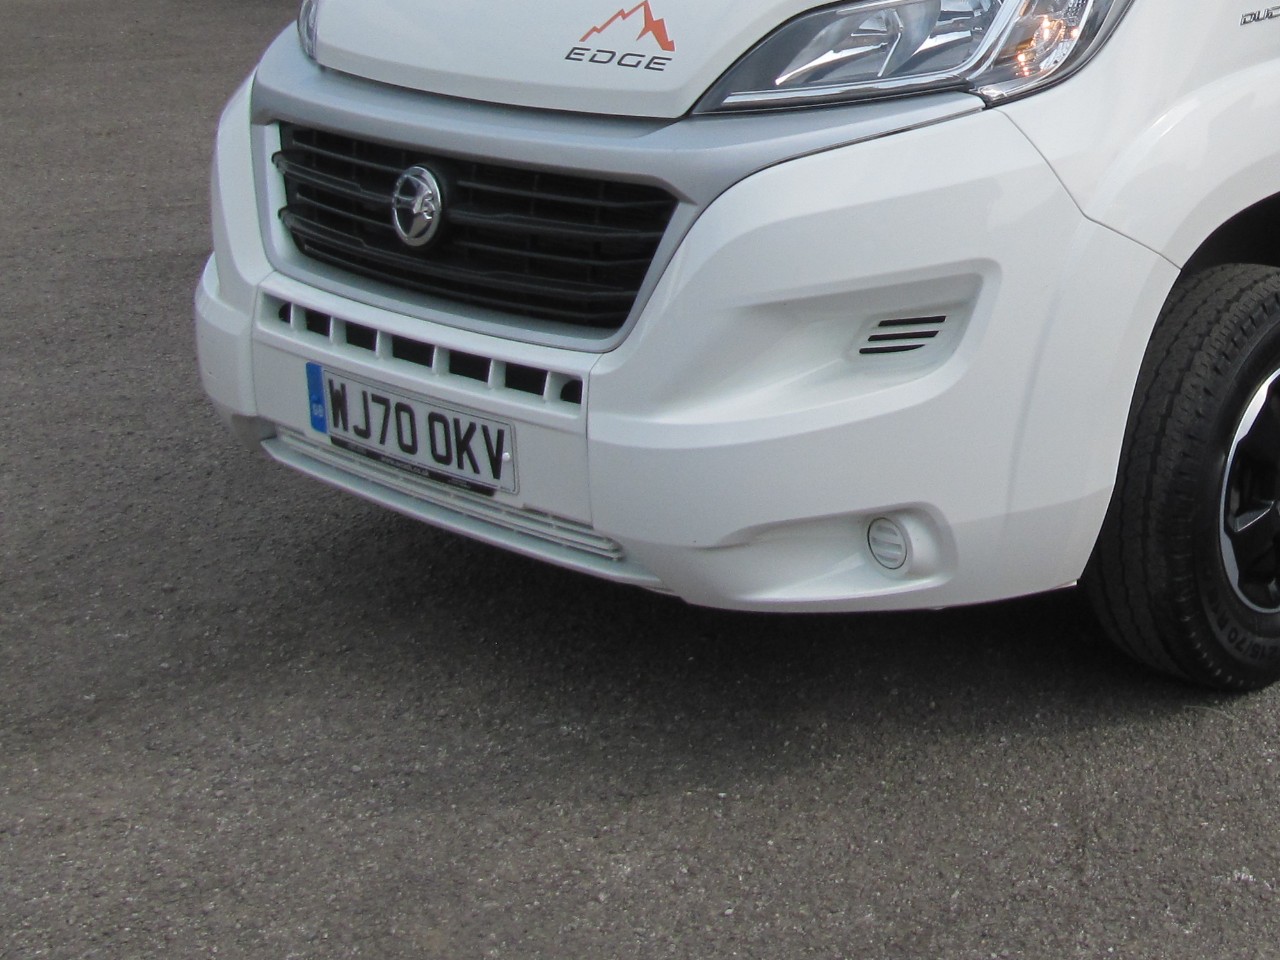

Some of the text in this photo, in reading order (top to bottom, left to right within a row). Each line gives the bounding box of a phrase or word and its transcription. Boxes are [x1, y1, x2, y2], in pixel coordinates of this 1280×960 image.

[564, 46, 673, 72] EDGE
[328, 379, 505, 480] WJ70 OKV
